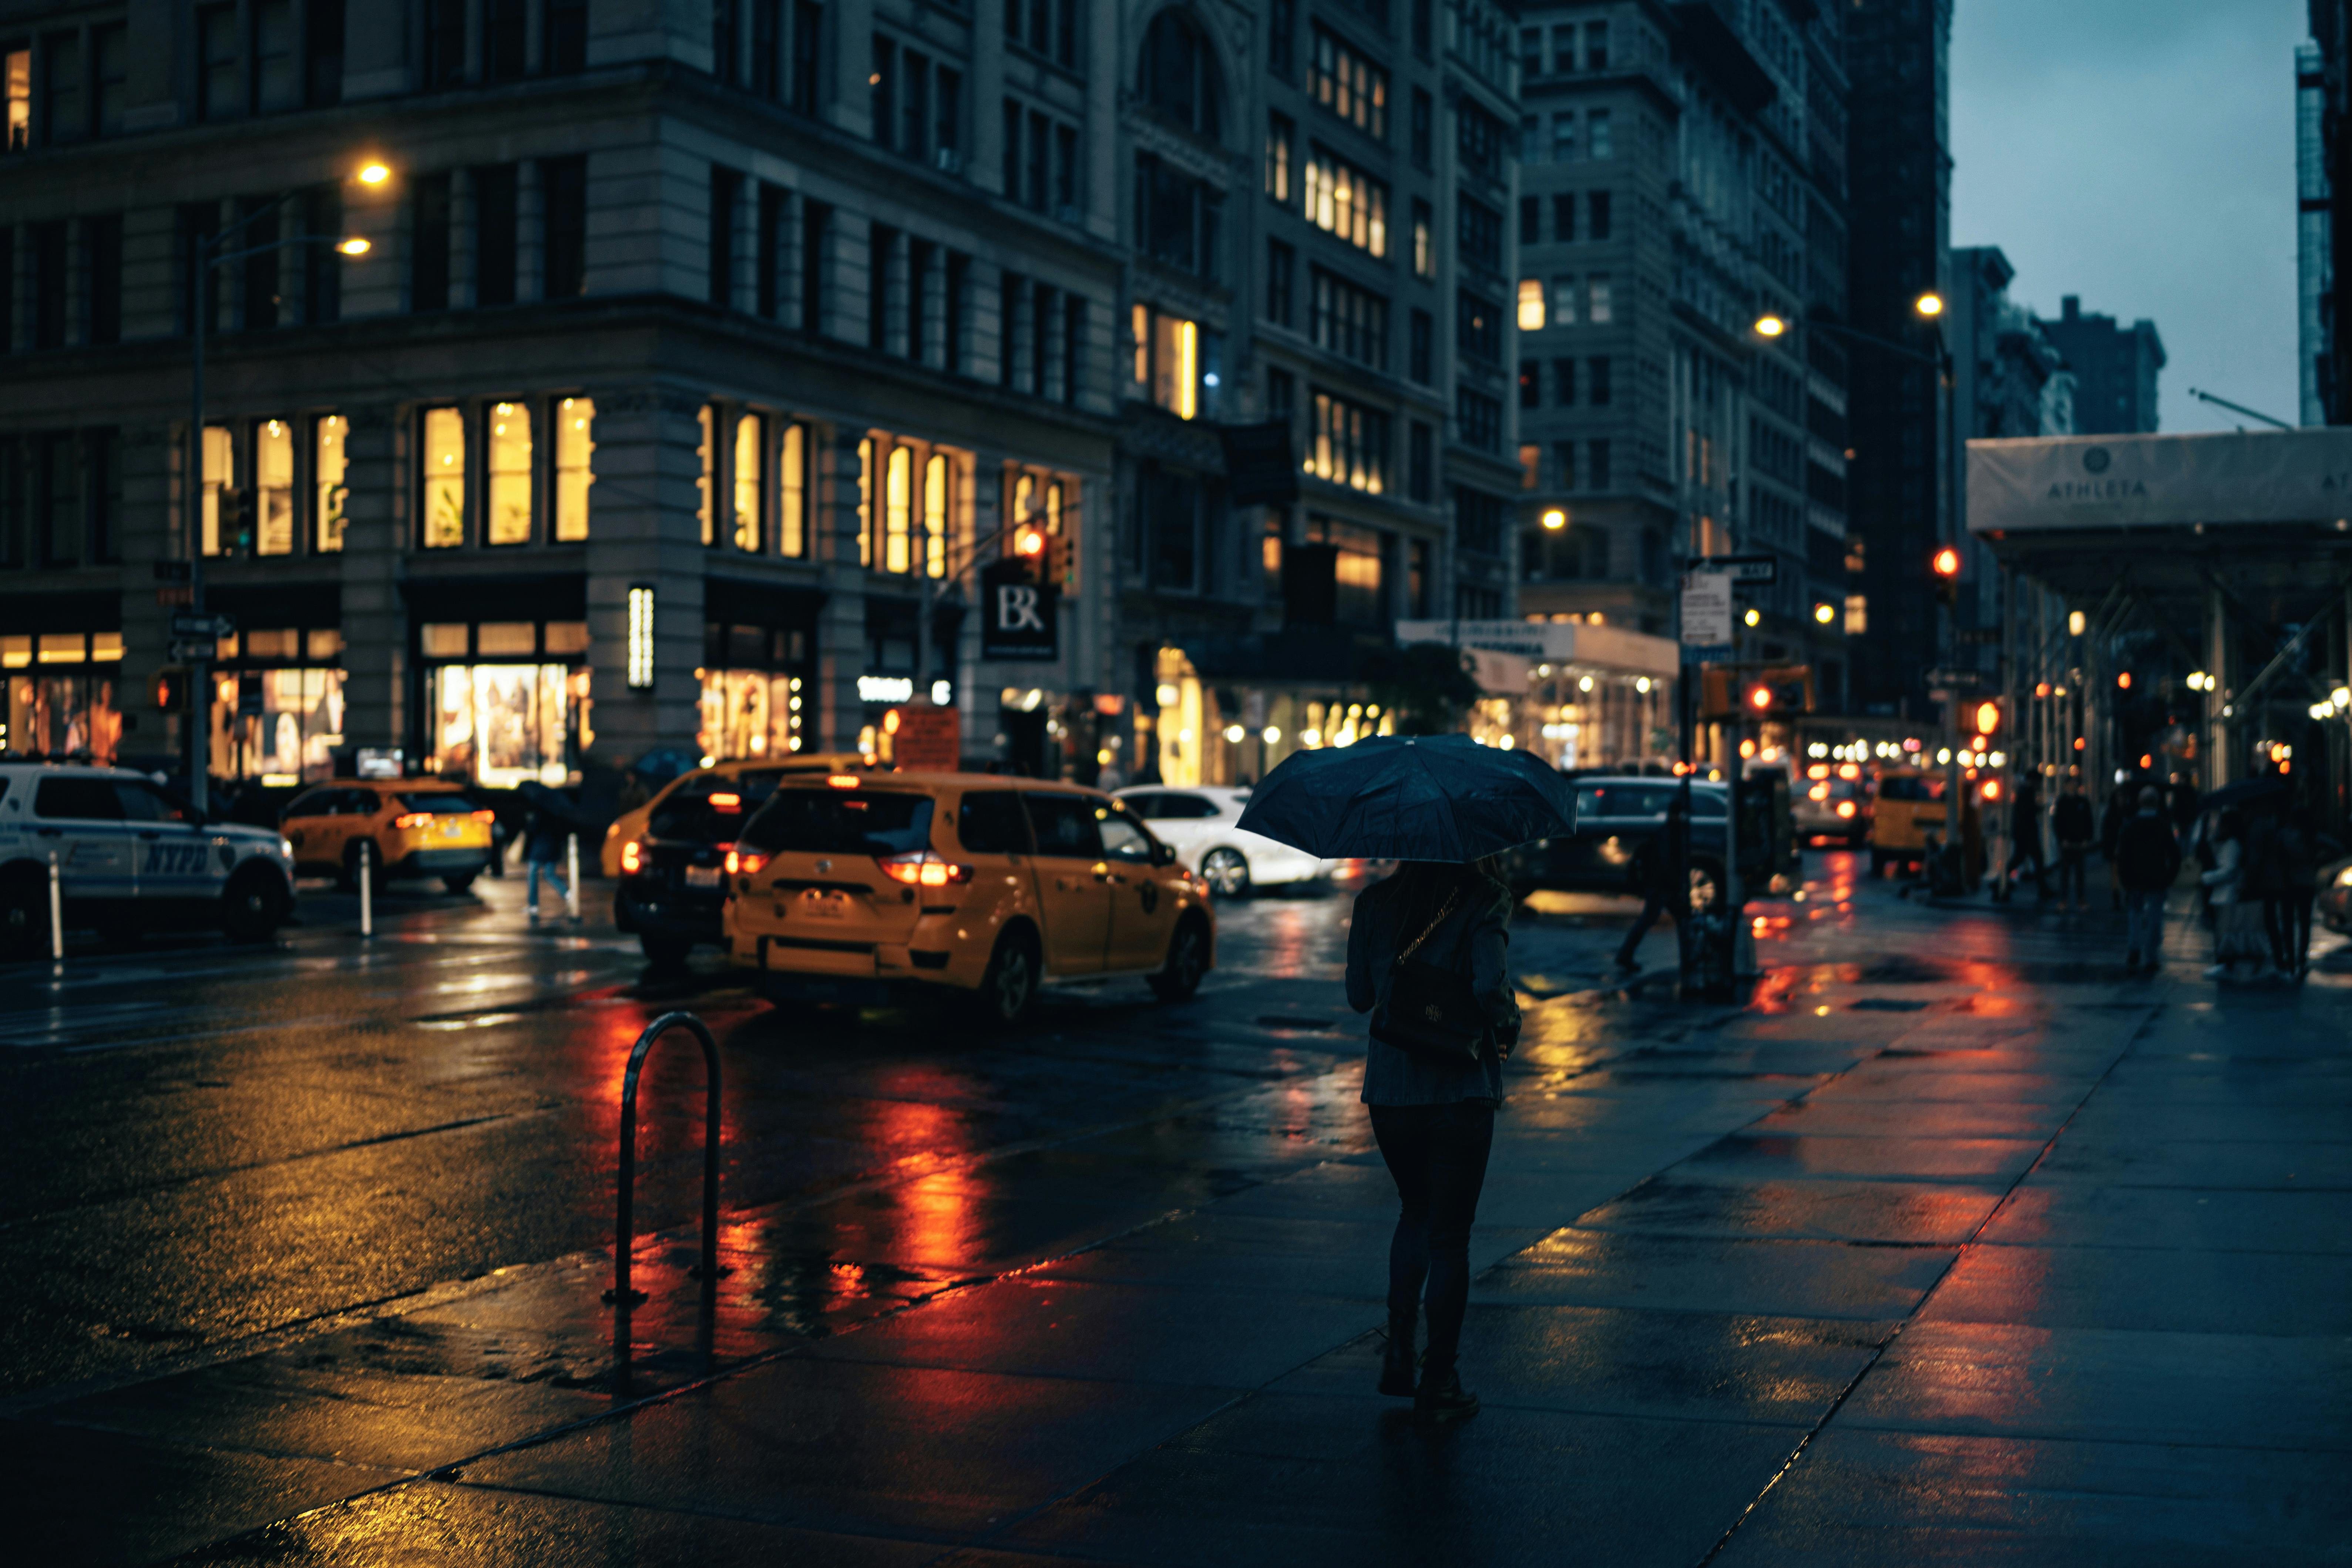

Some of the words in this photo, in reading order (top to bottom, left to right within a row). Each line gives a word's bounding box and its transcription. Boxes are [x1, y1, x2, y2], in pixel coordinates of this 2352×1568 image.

[2047, 480, 2148, 498] ATHLETA
[997, 585, 1044, 632] BR
[145, 844, 208, 873] NYPD
